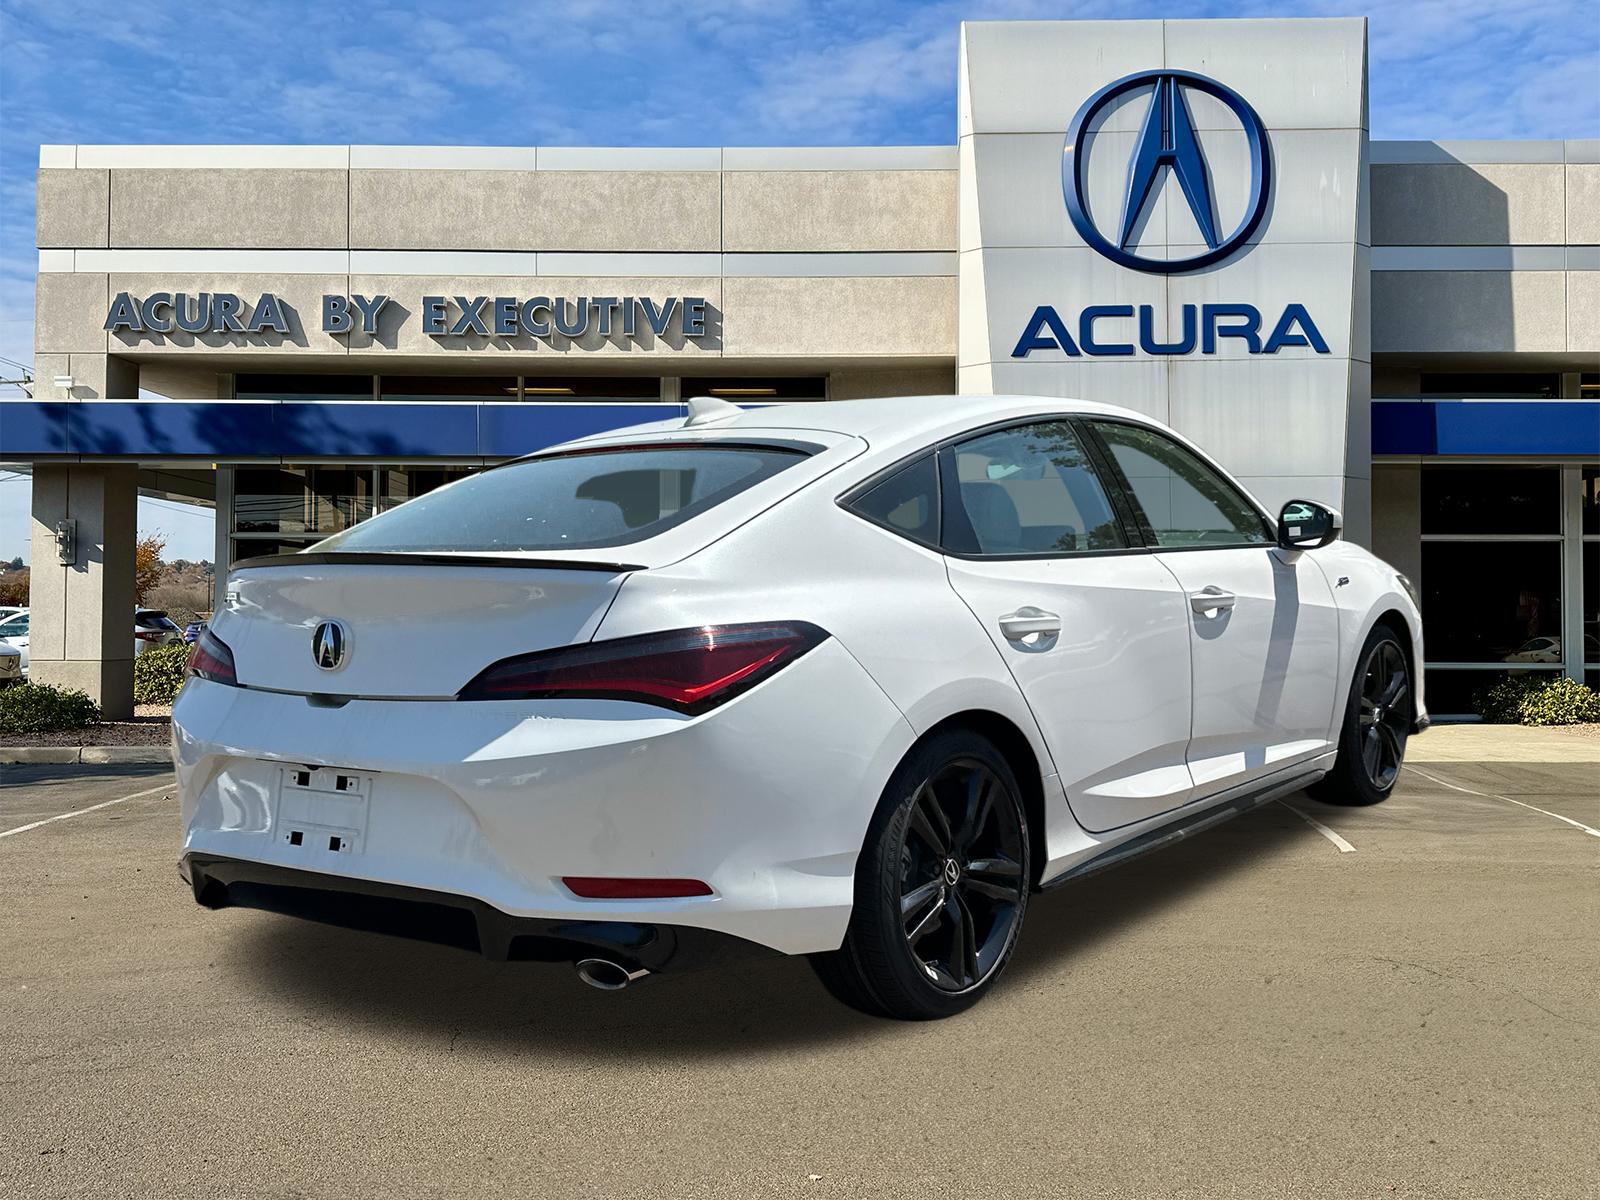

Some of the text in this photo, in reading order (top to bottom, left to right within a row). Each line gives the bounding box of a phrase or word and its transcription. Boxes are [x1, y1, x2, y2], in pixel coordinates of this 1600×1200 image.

[103, 292, 707, 337] ACURA BY EXECUTIVE
[1011, 303, 1332, 357] ACURA
